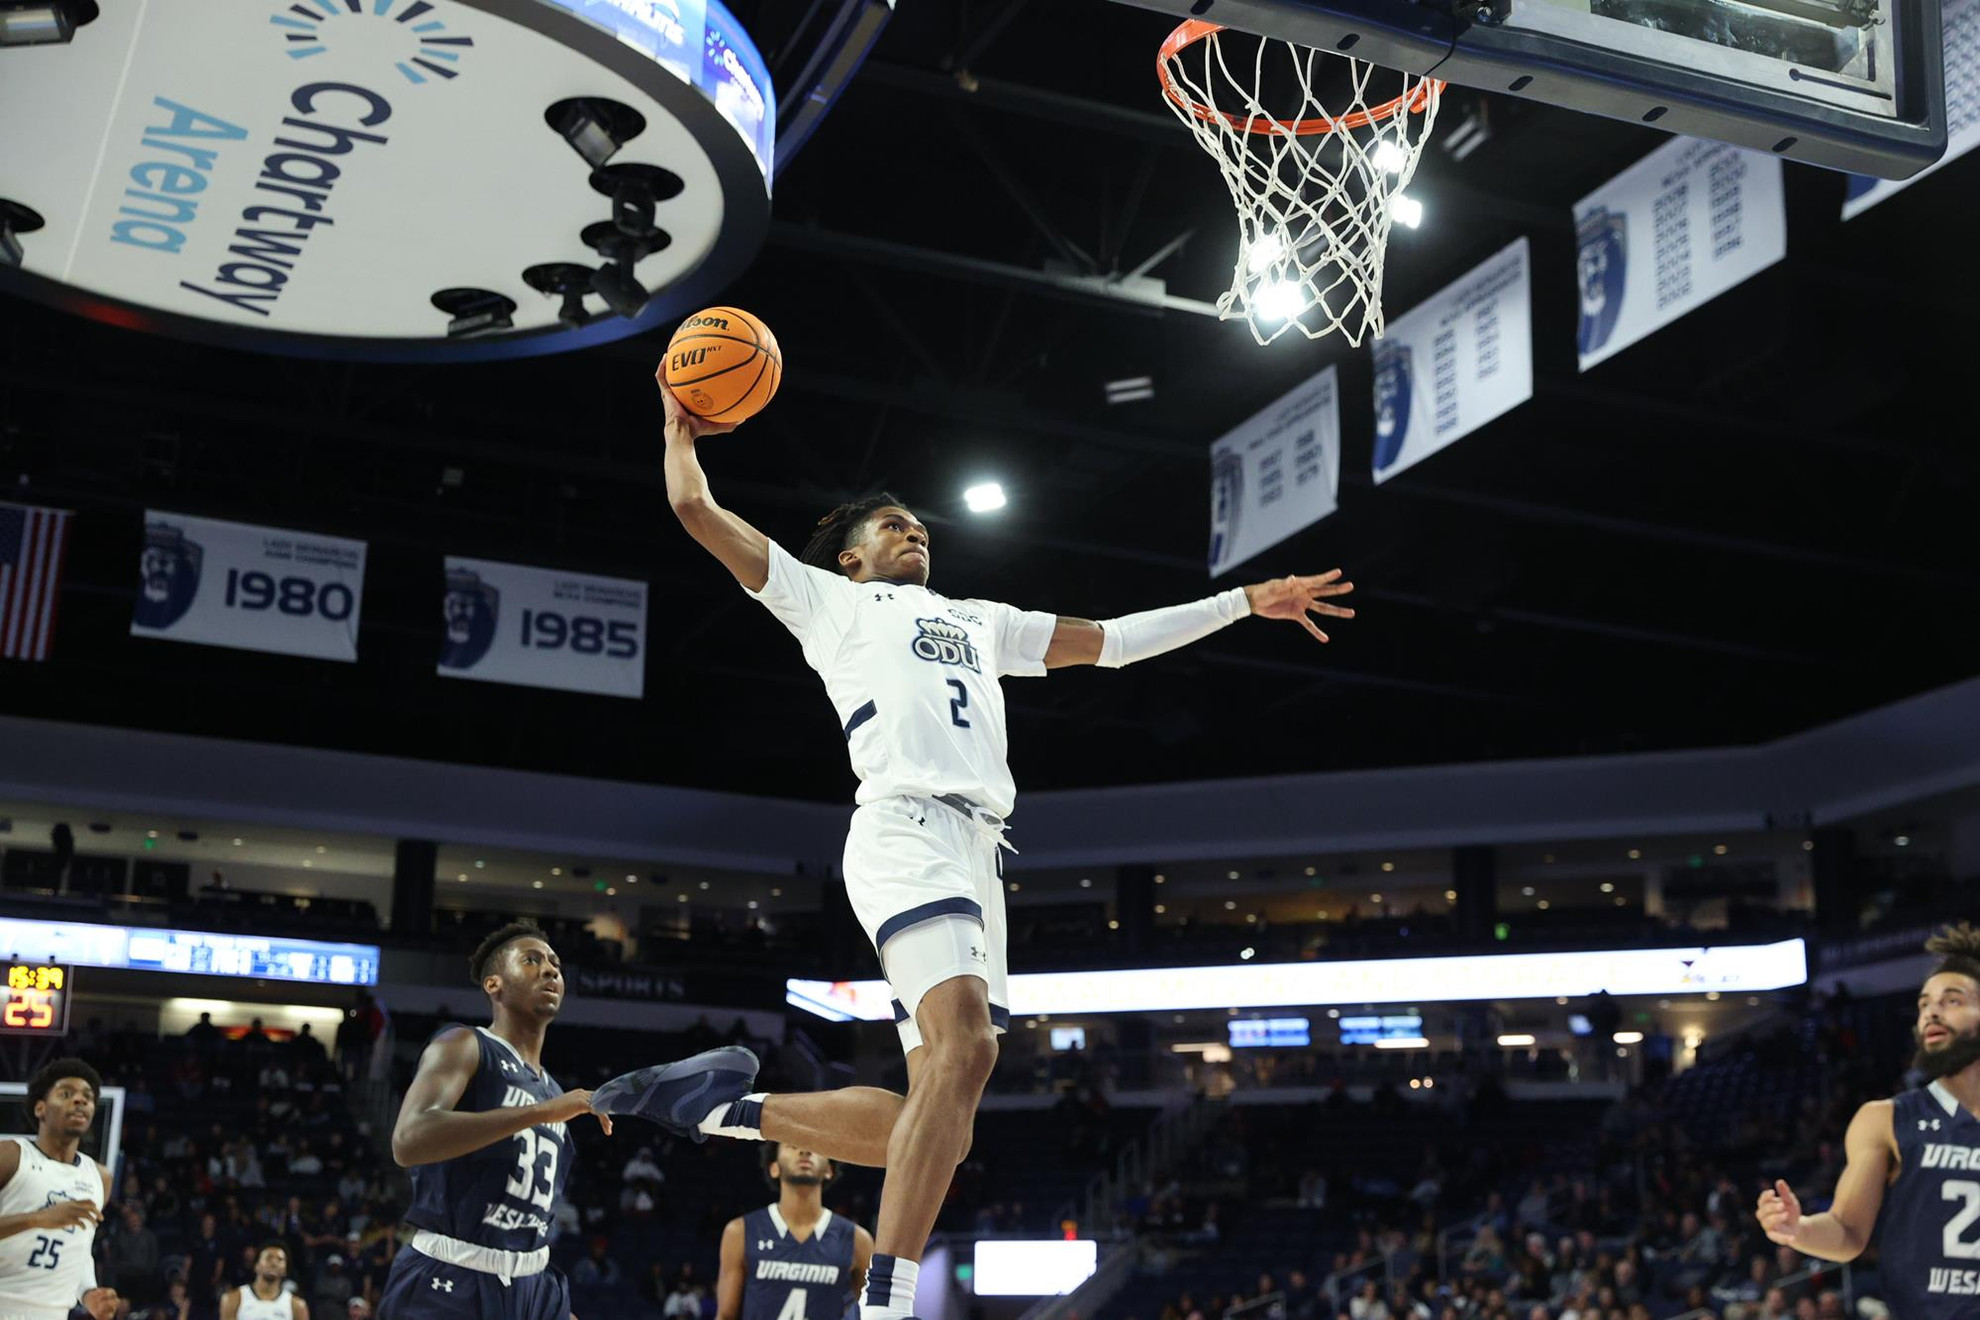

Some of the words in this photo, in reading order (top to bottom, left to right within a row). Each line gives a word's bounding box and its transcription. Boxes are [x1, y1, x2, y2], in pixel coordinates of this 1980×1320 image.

[109, 95, 249, 254] Arena
[180, 81, 393, 316] Chartway
[225, 567, 354, 622] 1980
[521, 608, 639, 660] 1985
[912, 633, 982, 674] ODU
[945, 678, 971, 728] 2
[4, 988, 53, 1027] 25
[505, 1127, 558, 1212] 33
[27, 1235, 64, 1270] 25
[756, 1260, 840, 1285] VIRGINIA
